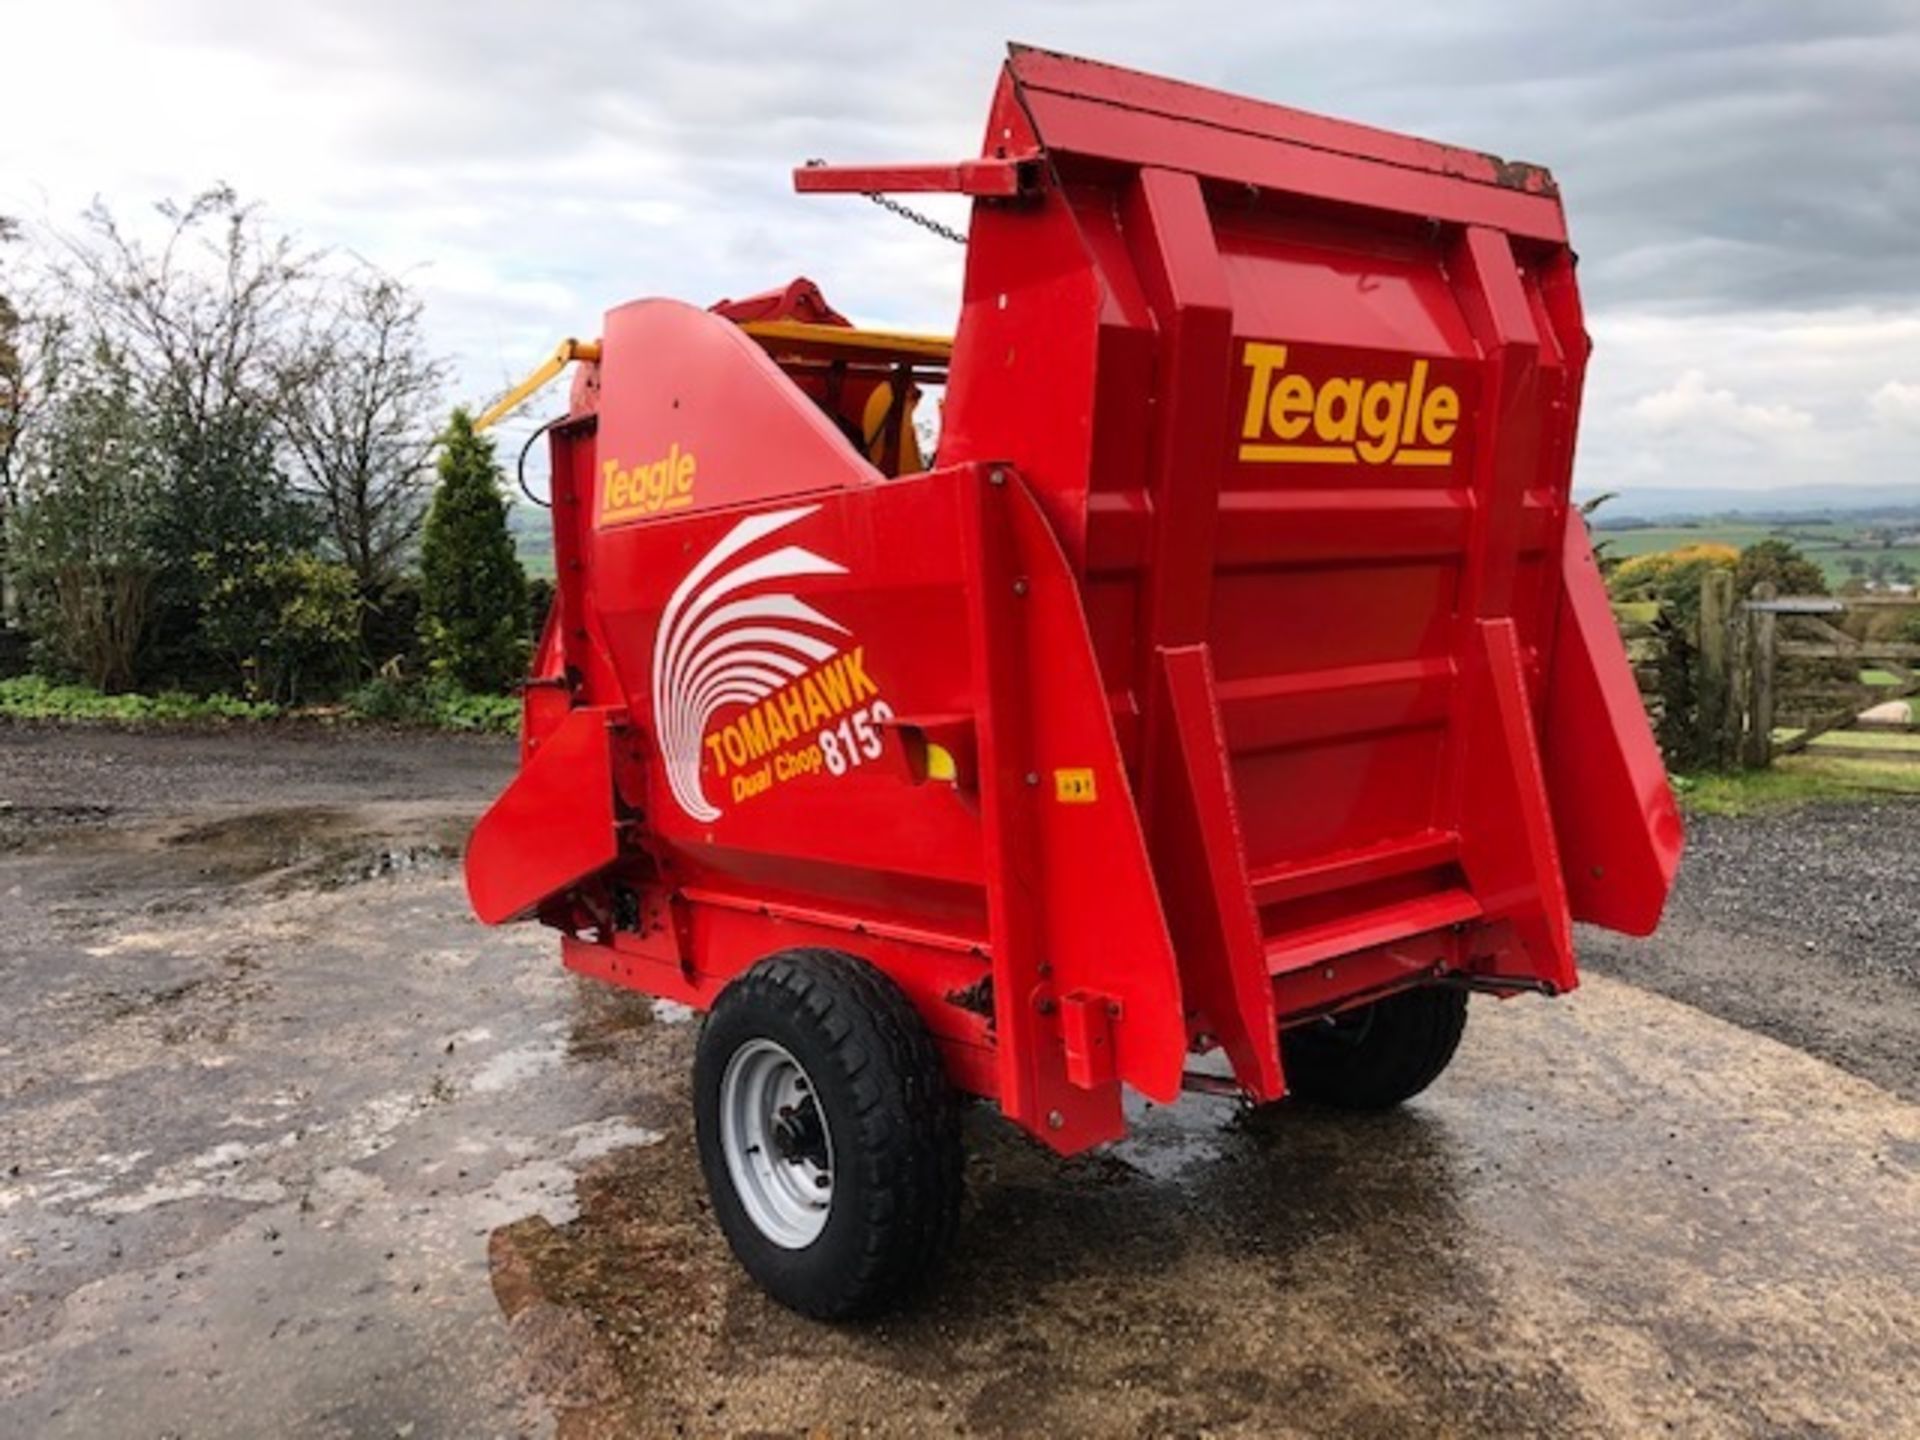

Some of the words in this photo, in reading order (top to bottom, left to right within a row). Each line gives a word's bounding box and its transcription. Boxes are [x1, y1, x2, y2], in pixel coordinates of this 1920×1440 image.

[1242, 342, 1459, 463] Teagle
[602, 443, 695, 512] Teagle
[705, 646, 878, 776] TOMAHAWK
[732, 762, 772, 803] Dual
[774, 744, 822, 781] Chop
